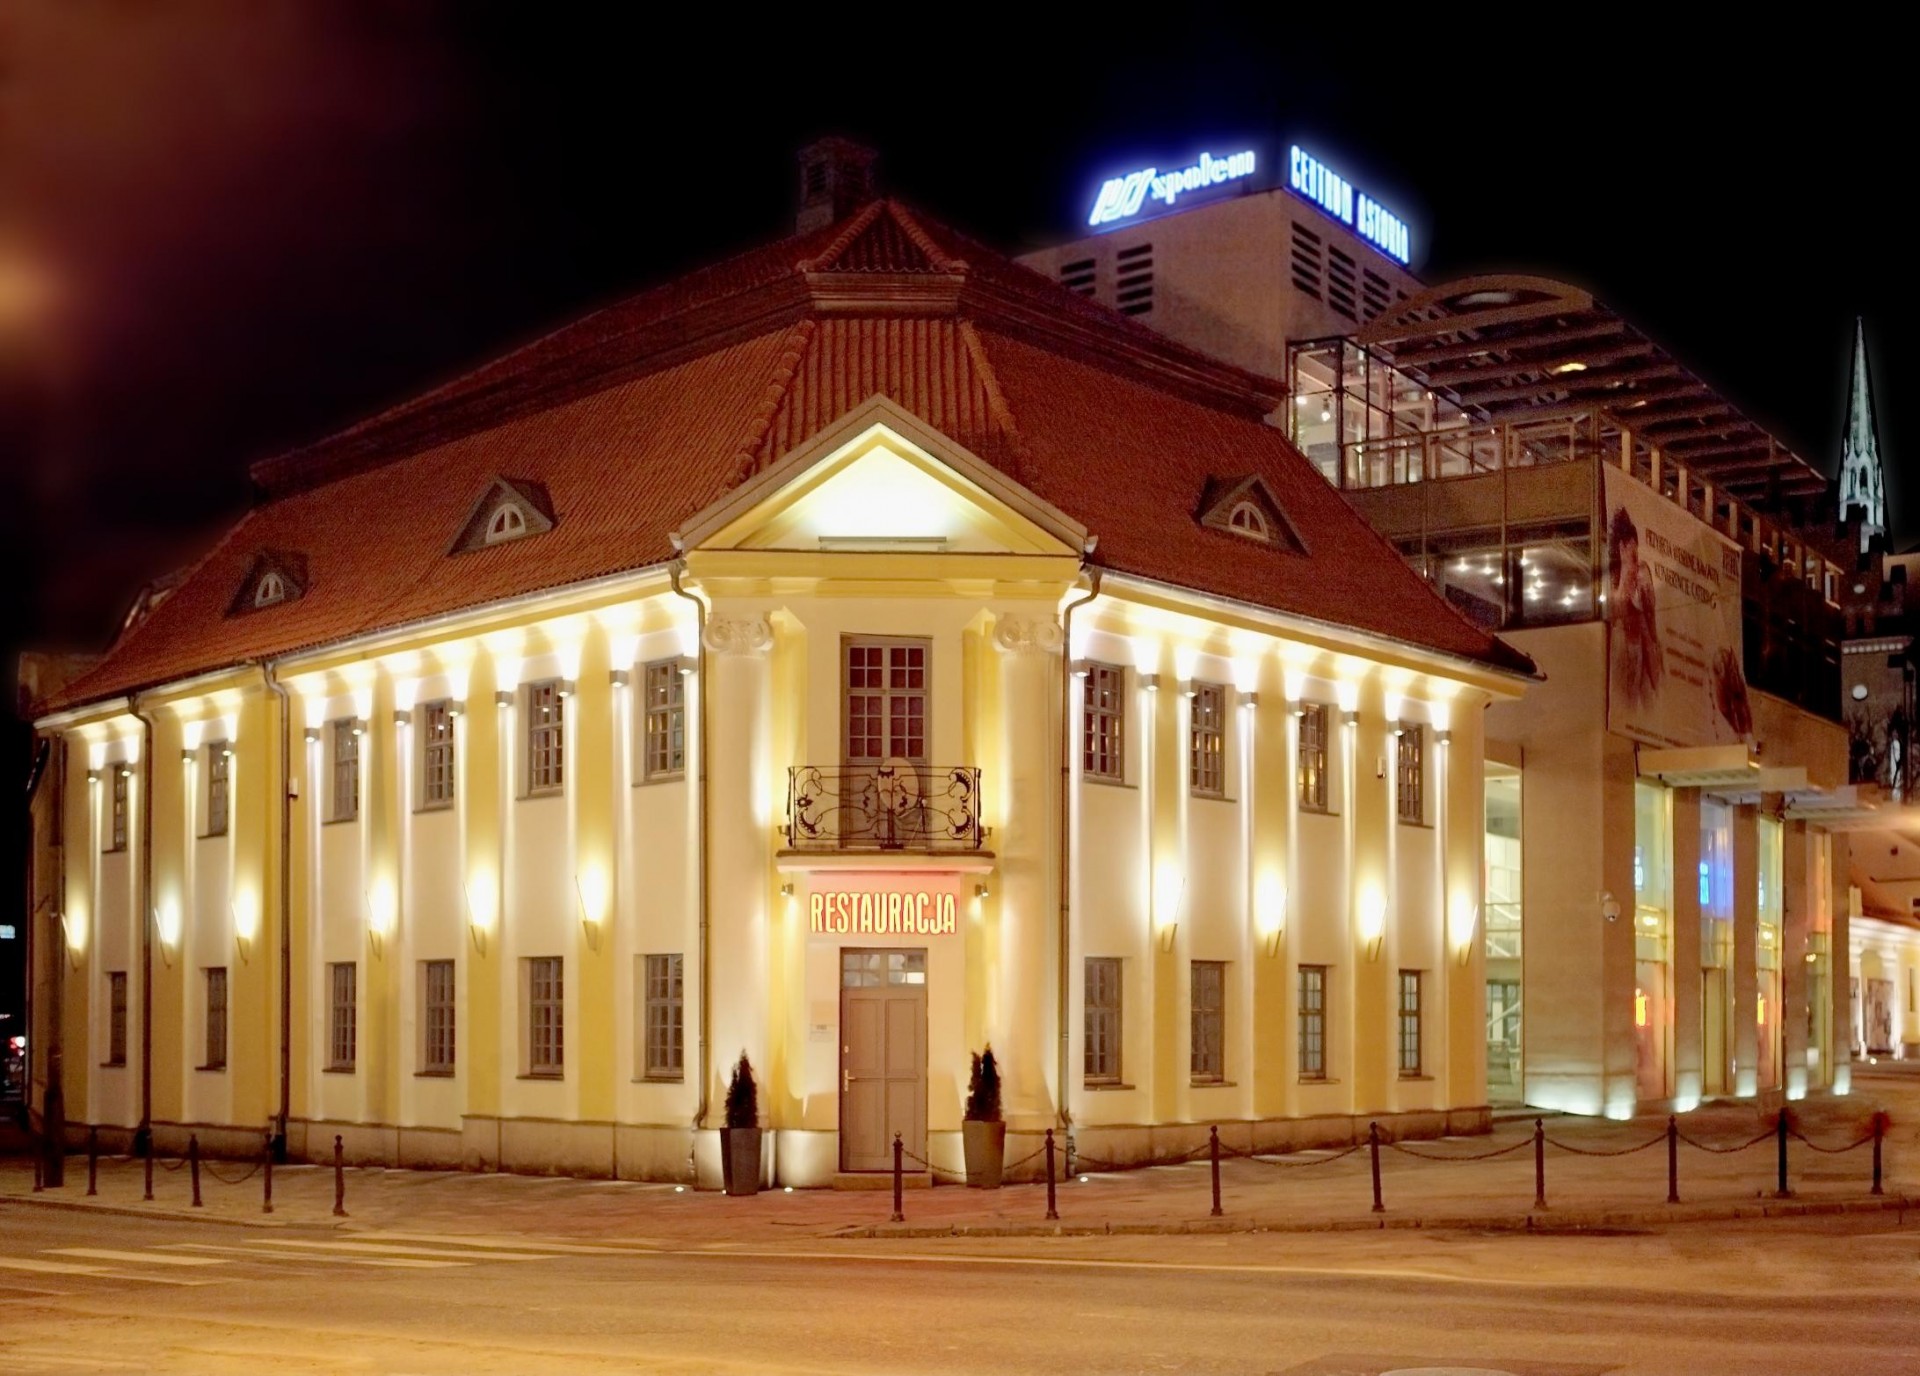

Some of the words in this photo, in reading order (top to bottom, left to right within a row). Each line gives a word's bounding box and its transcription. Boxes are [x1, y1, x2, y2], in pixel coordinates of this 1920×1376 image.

[1291, 145, 1353, 225] CENTRUM
[1357, 193, 1409, 264] ASTORIA
[810, 892, 956, 935] RESTAURACJA
